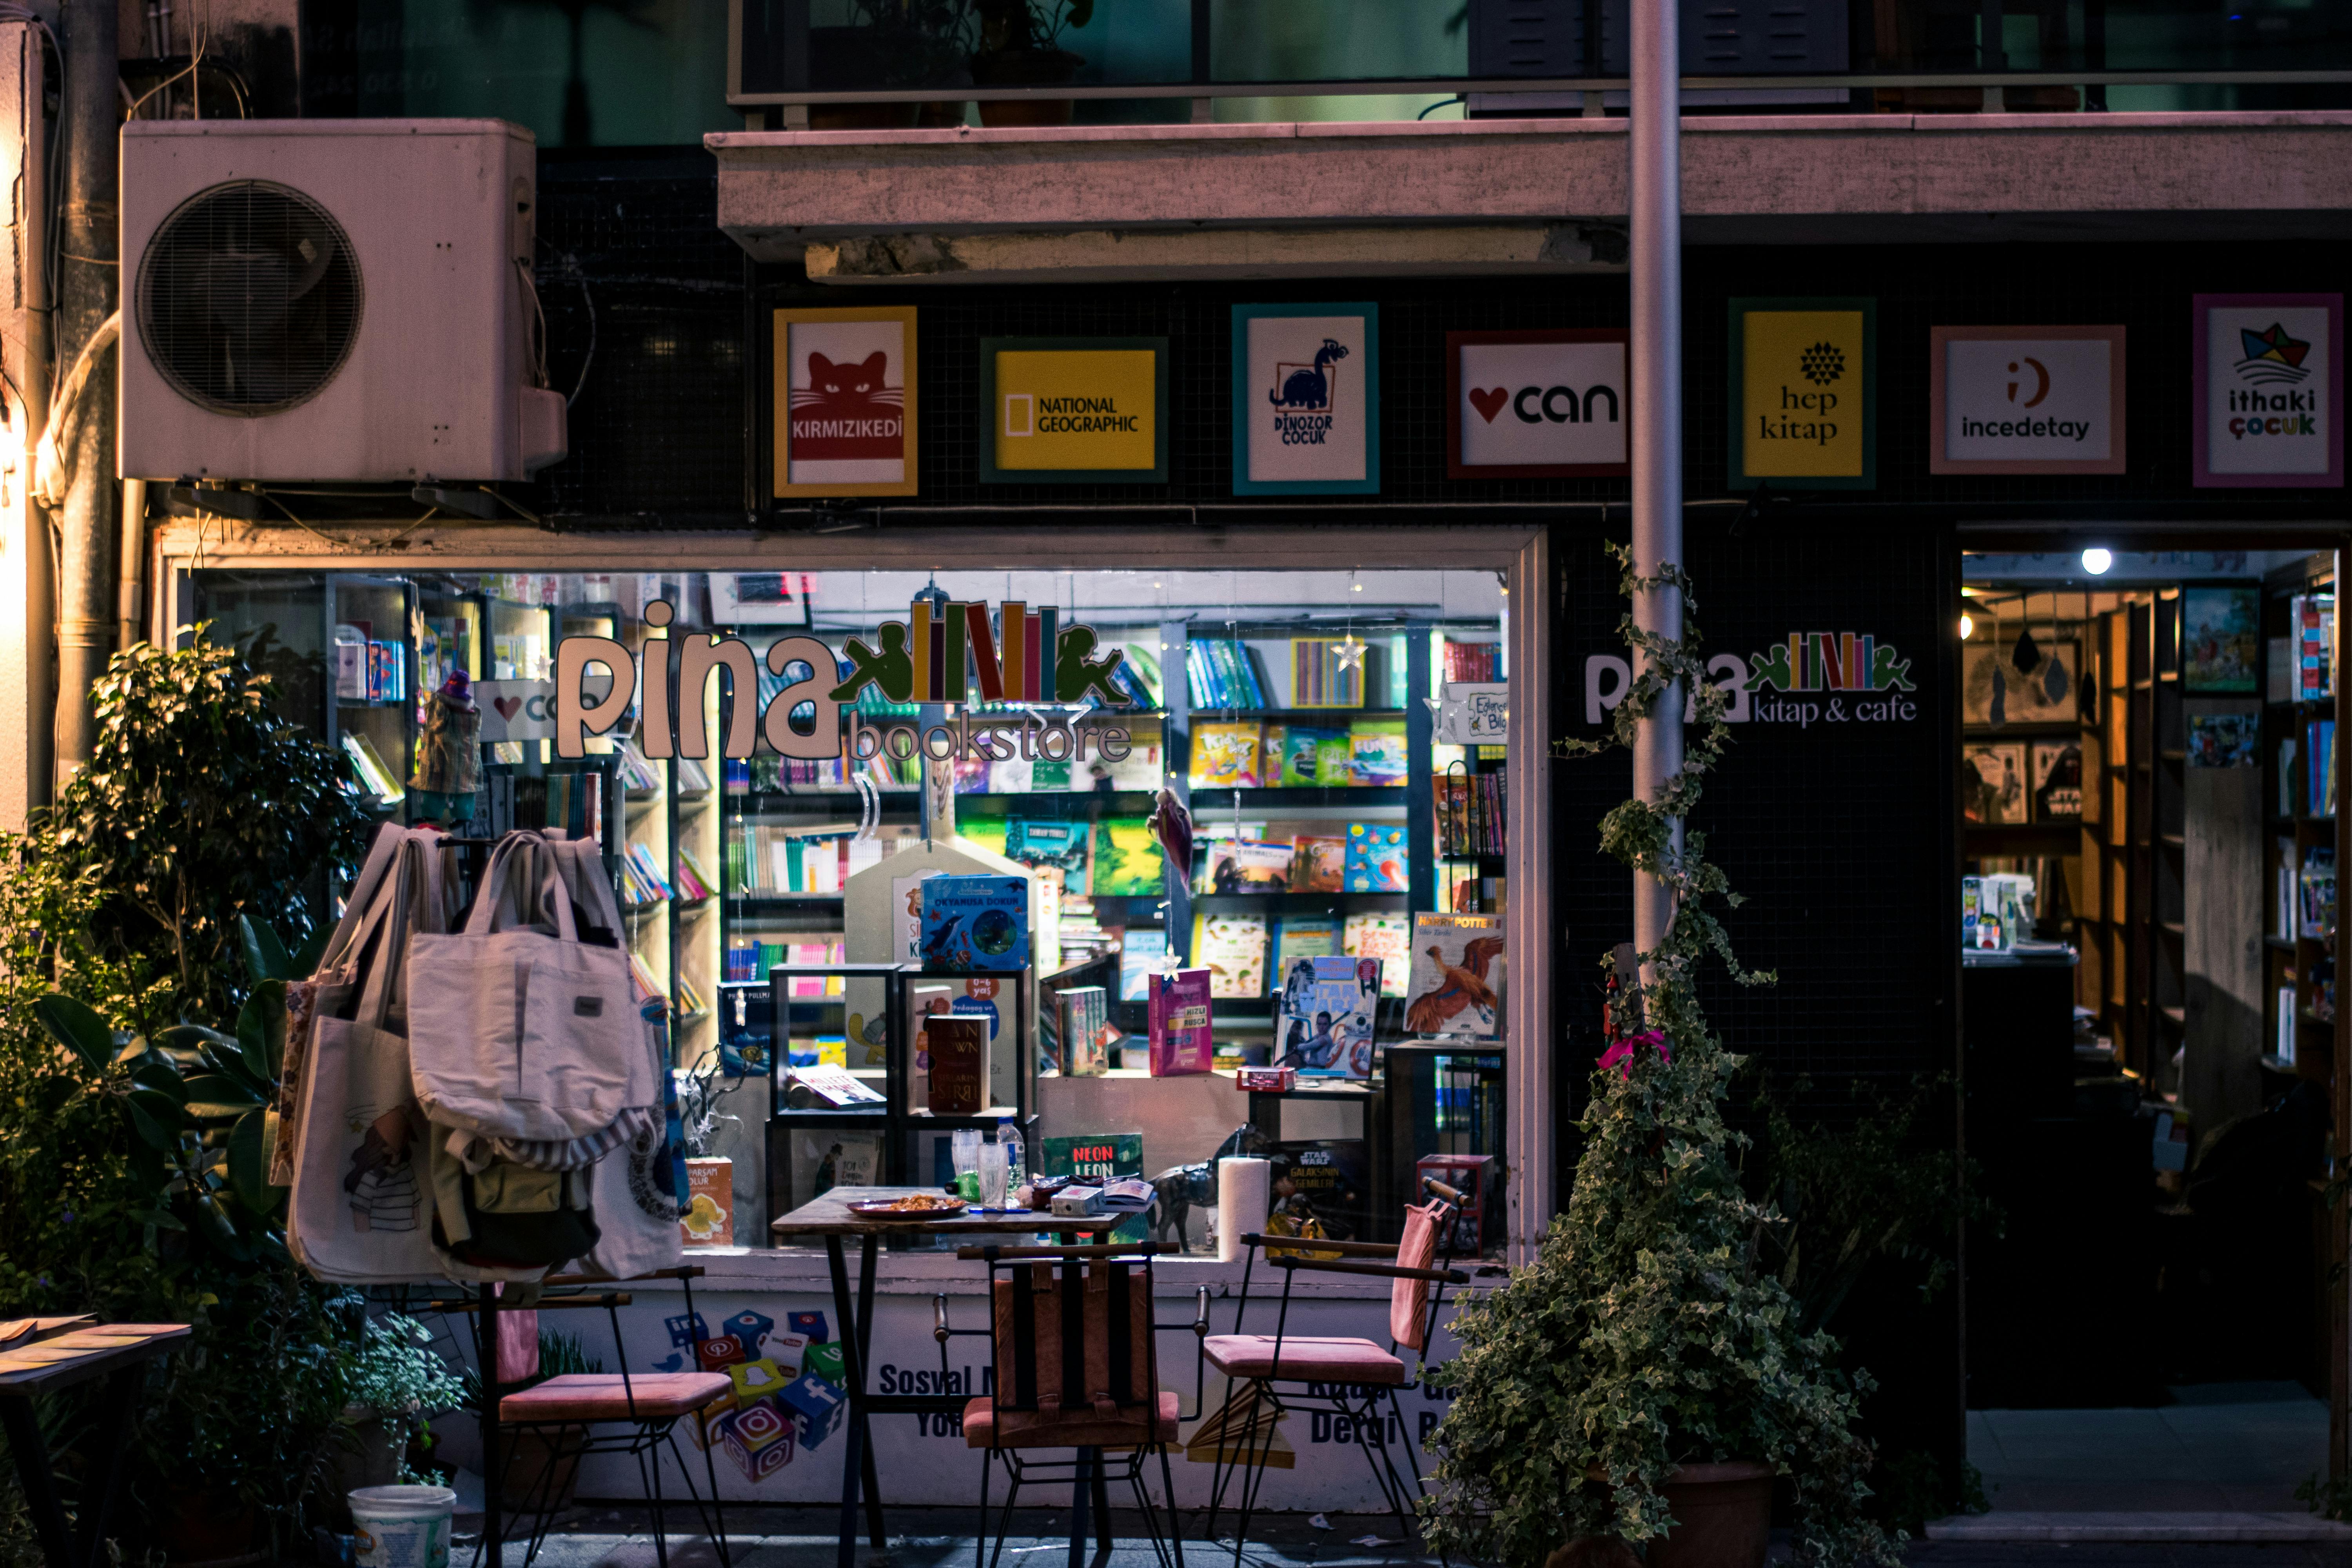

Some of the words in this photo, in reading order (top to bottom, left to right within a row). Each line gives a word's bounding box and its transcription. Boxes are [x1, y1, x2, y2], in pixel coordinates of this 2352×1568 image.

[1040, 397, 1117, 414] NATIONAL
[1513, 385, 1619, 424] can
[1781, 385, 1837, 416] hep
[2229, 390, 2315, 412] ithaki
[793, 415, 903, 438] KIRMIZIKEDİ
[1038, 416, 1138, 433] GEOGRAPHIC
[1275, 412, 1332, 431] DİNOZOR
[1759, 415, 1837, 446] kitap
[1962, 416, 2090, 441] incedetay
[2229, 414, 2316, 440] çocuk
[1282, 430, 1326, 446] ÇOCUK
[556, 599, 842, 760] pina
[1754, 695, 1818, 729] kitap
[1824, 697, 1851, 722] &
[1855, 695, 1917, 722] cafe
[849, 709, 1131, 763] bookstore
[935, 897, 983, 907] OKYANUSA
[987, 897, 1019, 906] DOKUN
[1418, 916, 1454, 927] HARRY
[1454, 916, 1494, 929] POTTER
[974, 987, 991, 998] yaş
[1187, 1007, 1206, 1016] HIZLI
[1073, 1145, 1113, 1163] NEON
[1299, 1151, 1330, 1159] STAR
[1299, 1156, 1330, 1165] WARS
